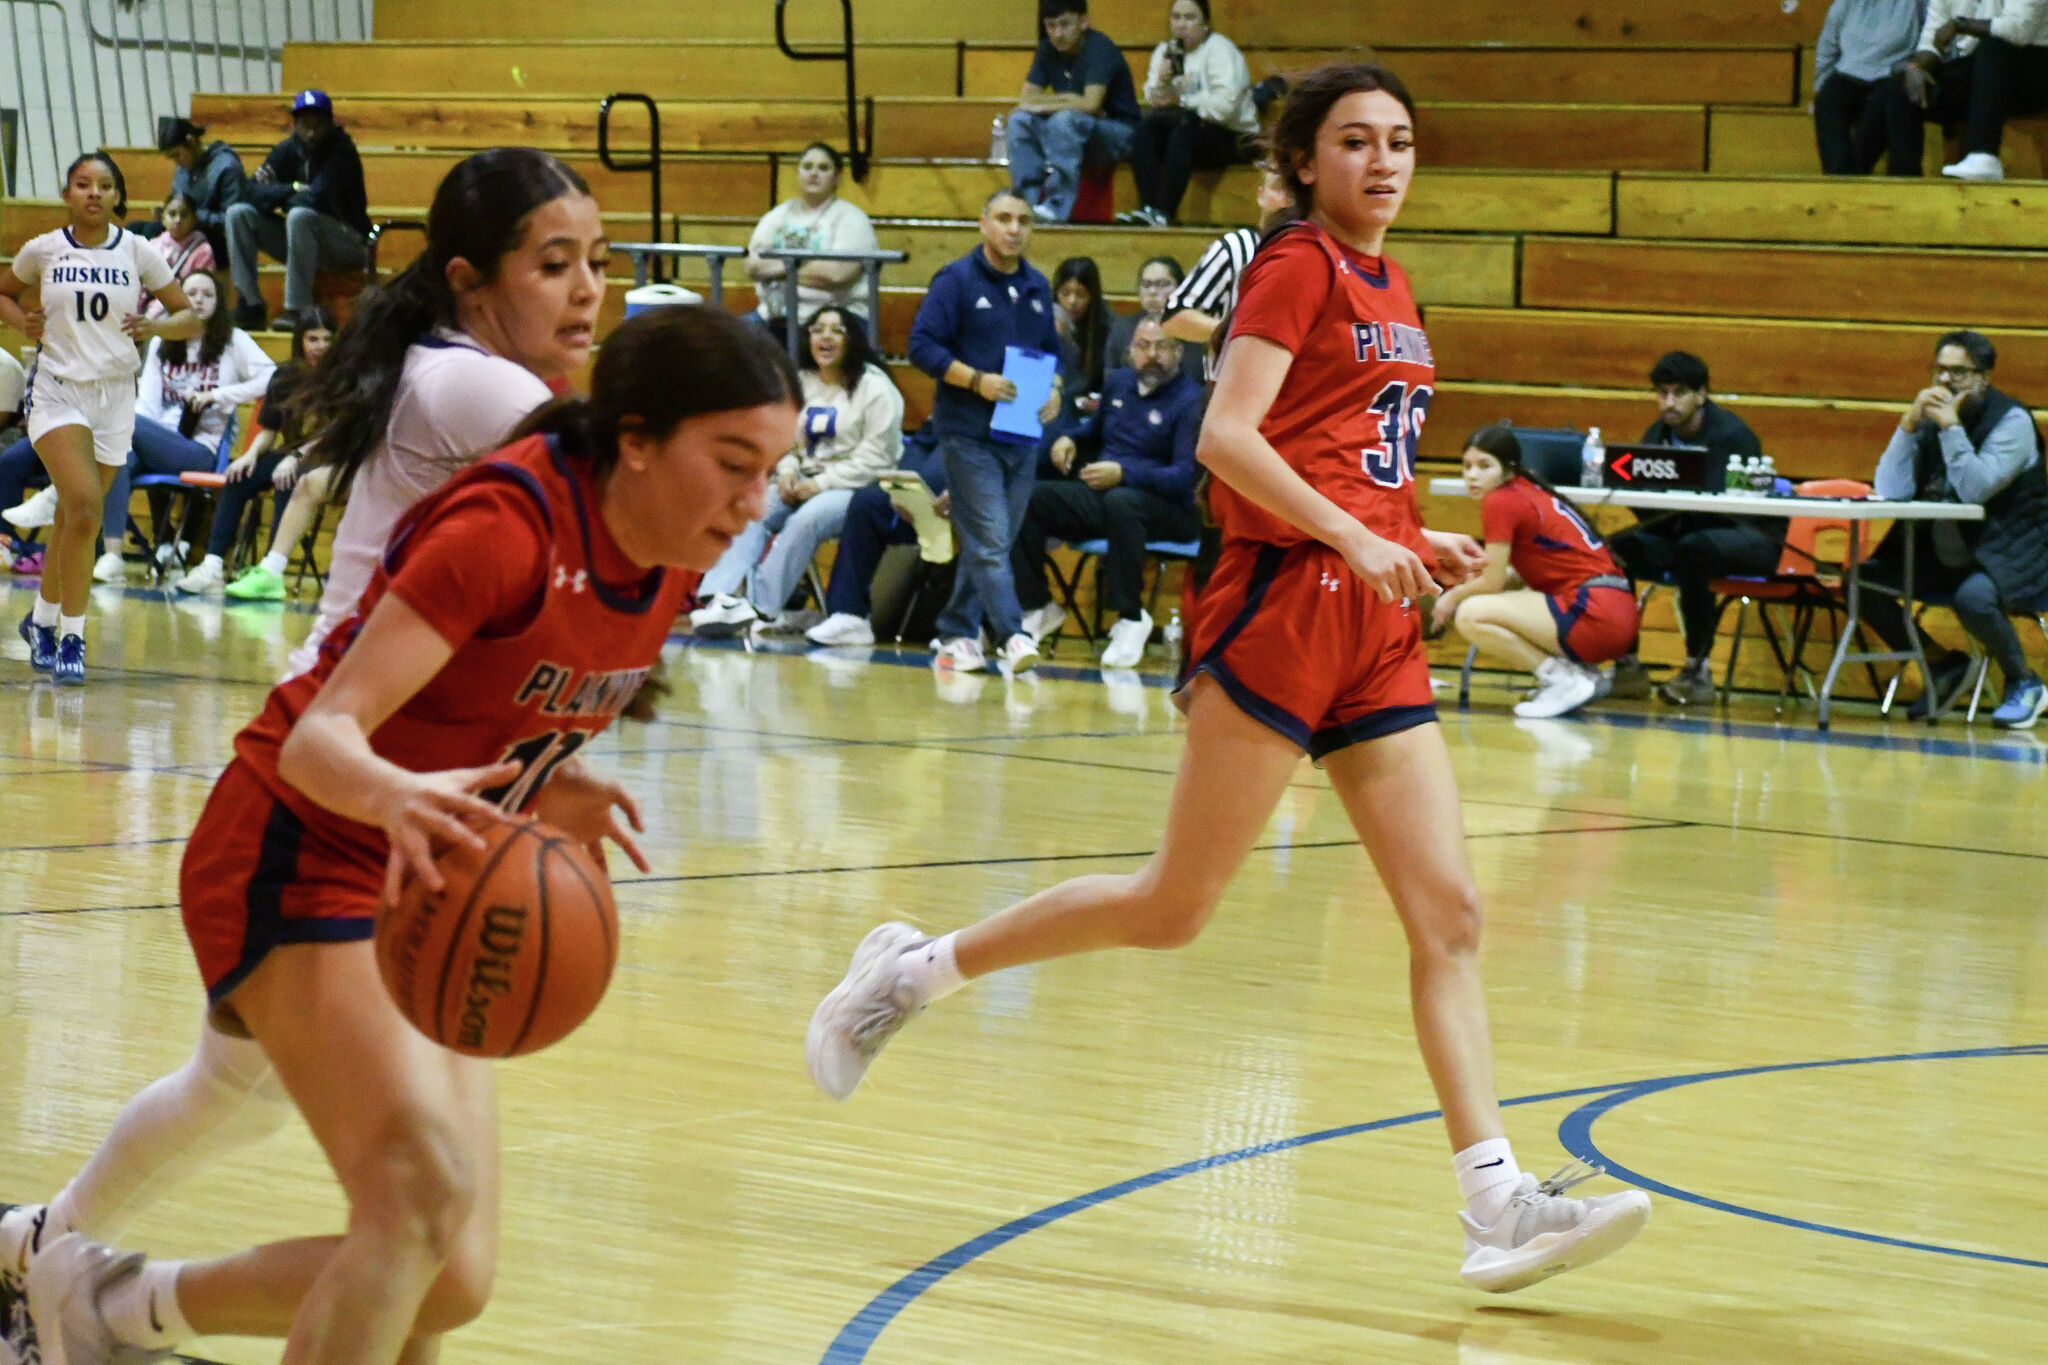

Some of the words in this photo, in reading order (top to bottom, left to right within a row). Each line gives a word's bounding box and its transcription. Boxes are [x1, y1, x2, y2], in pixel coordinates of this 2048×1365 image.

[53, 266, 130, 287] HUSKIES
[75, 291, 109, 322] 10
[1632, 457, 1679, 480] POSS.
[456, 903, 528, 1048] Wilson
